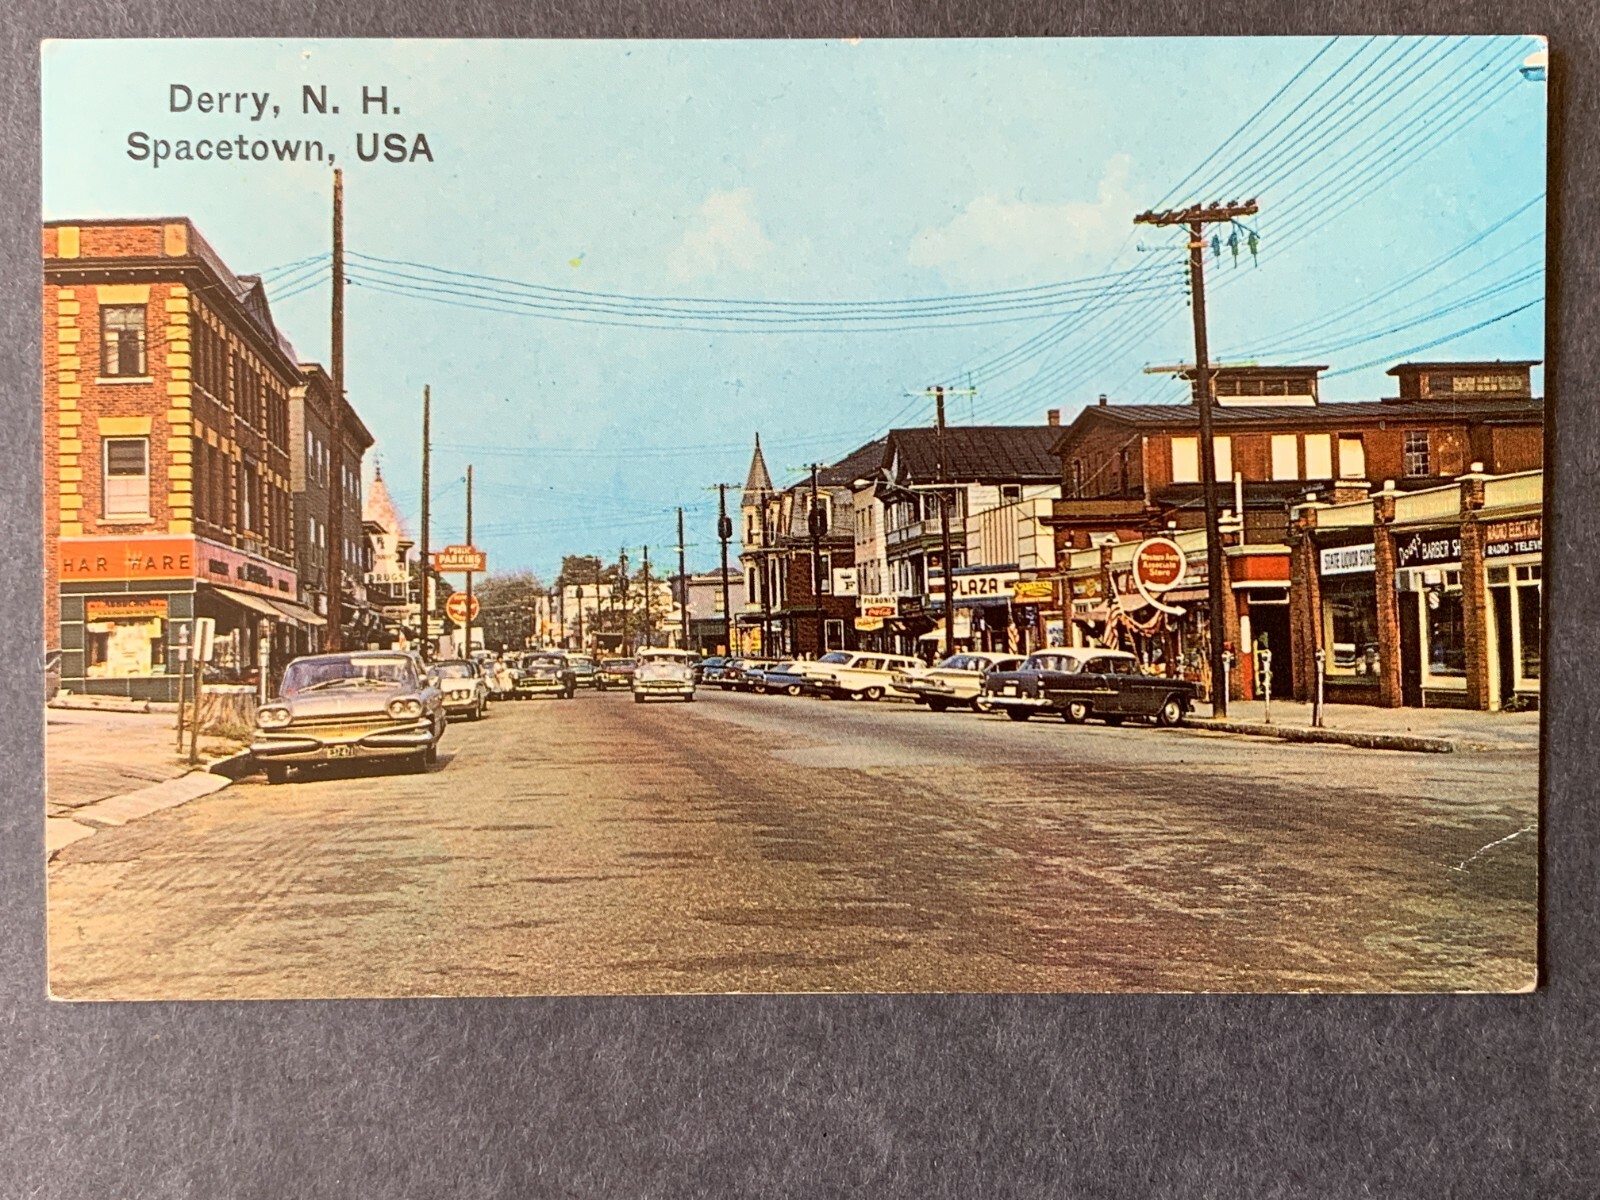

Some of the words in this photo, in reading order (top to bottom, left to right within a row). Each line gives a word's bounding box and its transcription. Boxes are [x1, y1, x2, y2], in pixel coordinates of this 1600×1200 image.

[1452, 539, 1461, 557] SH
[1487, 543, 1509, 555] RADIO
[439, 554, 481, 564] PARKING
[369, 573, 405, 583] DRUGS
[1149, 569, 1171, 577] Store
[952, 578, 998, 595] PLAZA
